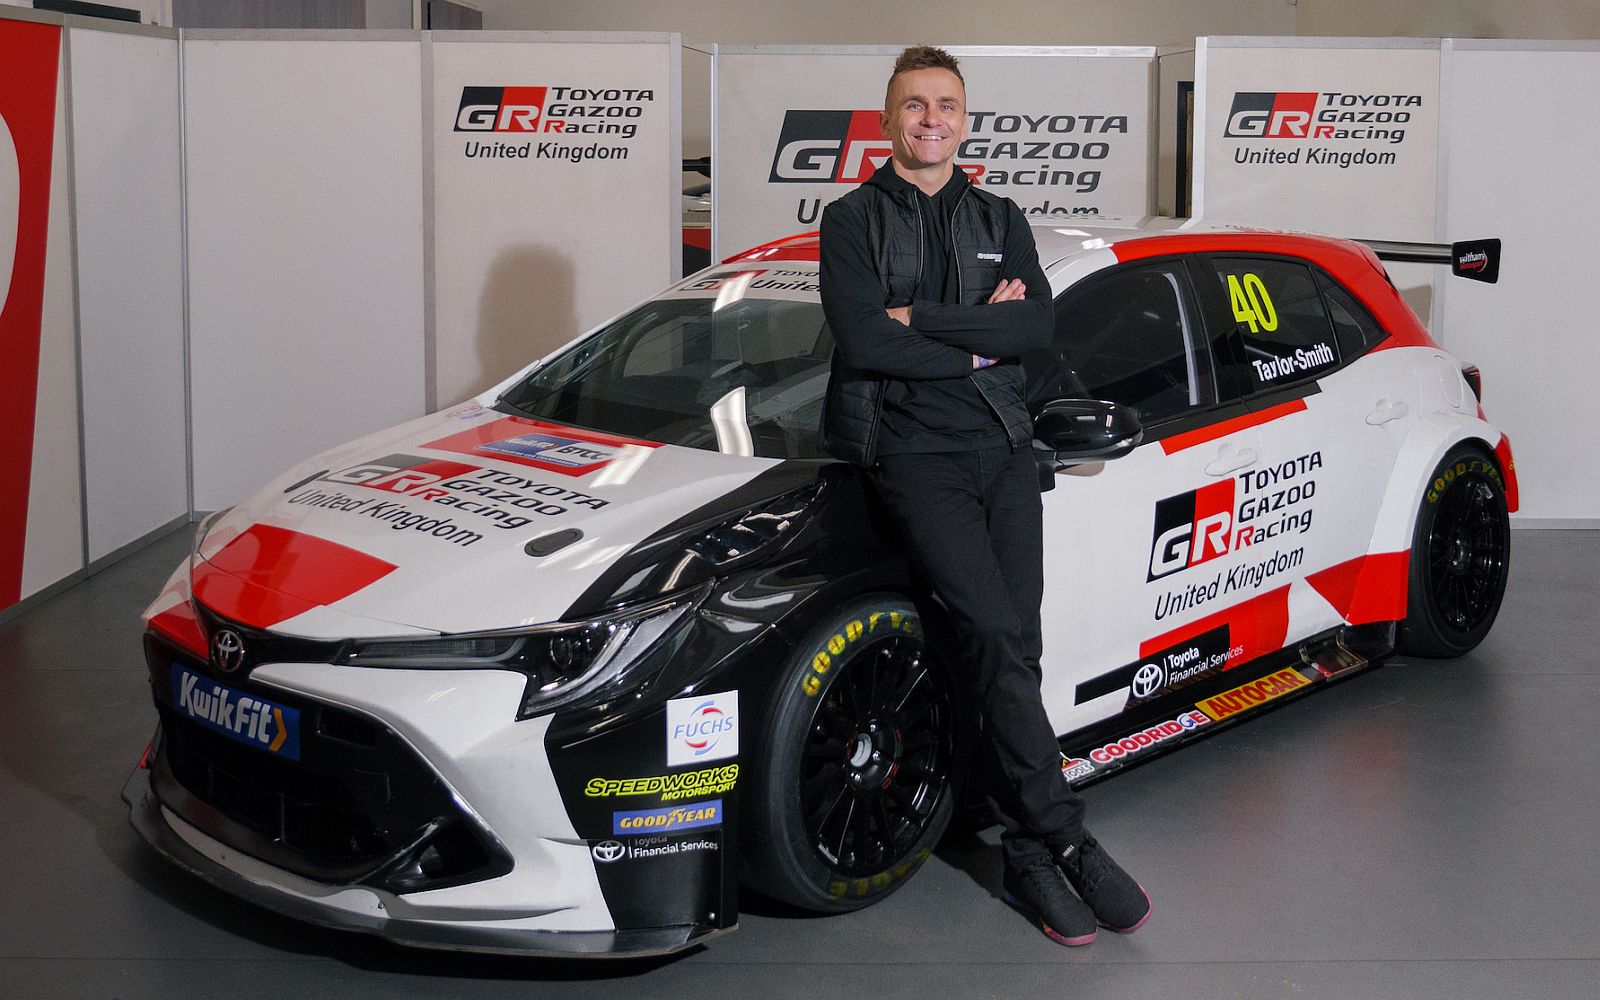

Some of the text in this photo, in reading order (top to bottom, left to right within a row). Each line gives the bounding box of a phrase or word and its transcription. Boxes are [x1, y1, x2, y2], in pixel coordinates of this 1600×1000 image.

[551, 87, 654, 101] TOYOTA
[1322, 92, 1422, 107] TOYOTA
[456, 104, 541, 131] GR
[547, 103, 643, 118] GAZOO
[967, 111, 1128, 134] TOYOTA
[1227, 110, 1311, 137] GR
[1317, 109, 1411, 123] GAZOO
[543, 120, 638, 139] Racing
[1313, 125, 1405, 144] Racing
[464, 141, 630, 163] United Kingdom
[956, 138, 1110, 160] GAZOO
[1233, 147, 1396, 168] United Kingdom
[967, 163, 1103, 193] Racing
[750, 279, 820, 292] Unite
[1227, 273, 1278, 333] 40
[1252, 342, 1334, 382] Taylor-Smith
[1239, 450, 1323, 494] TOYOTA
[441, 479, 568, 517] GAZOO
[476, 469, 611, 510] TOYOTA
[1238, 480, 1316, 523] GAZOO
[287, 489, 484, 547] United Kingdom
[416, 487, 533, 530] Racing
[1234, 508, 1313, 551] Racing
[1150, 511, 1232, 577] GR
[1154, 547, 1304, 621] United Kingdom
[1167, 647, 1200, 669] Toyota
[1168, 644, 1244, 686] Financial Services
[1207, 669, 1305, 718] AUTOCAR
[673, 716, 733, 740] FUCHS
[1090, 709, 1212, 764] GOODRIDGE
[585, 764, 739, 797] SPEEDWORKS
[661, 780, 737, 802] MOTORSPORT
[619, 806, 716, 829] GOODYEAR
[633, 839, 719, 859] Financial Services
